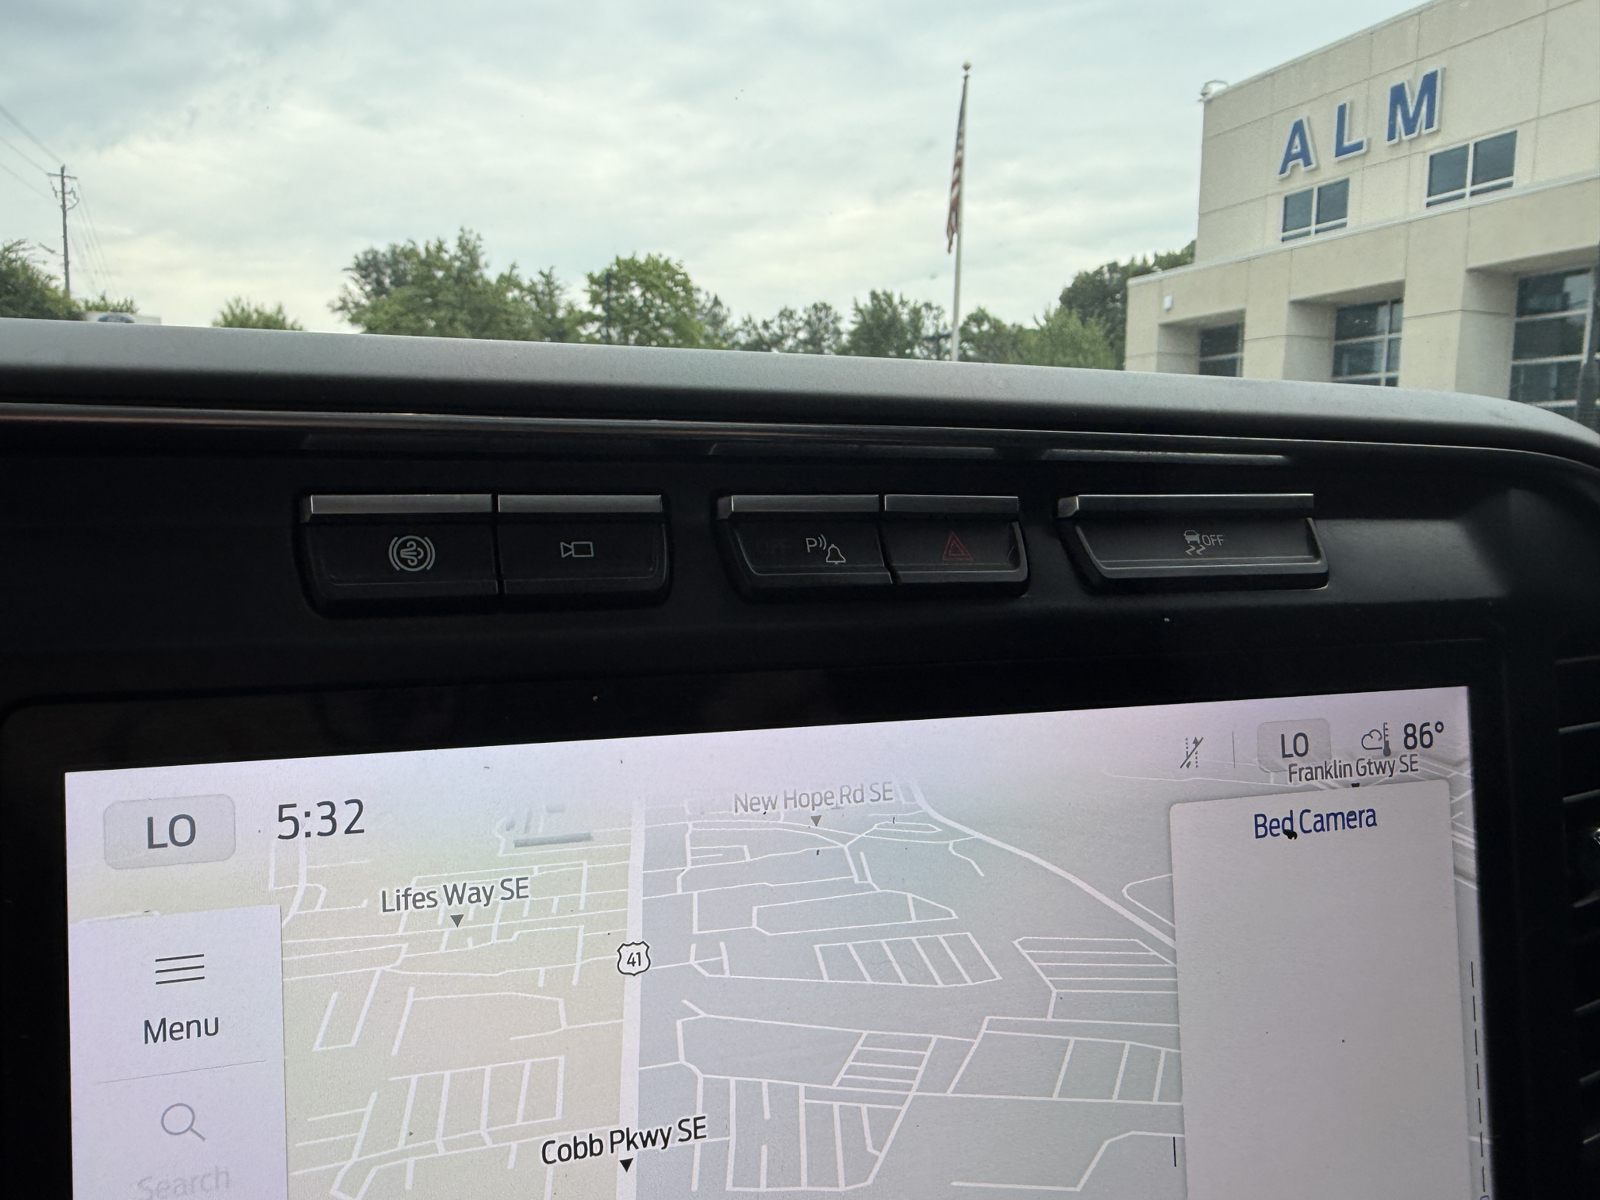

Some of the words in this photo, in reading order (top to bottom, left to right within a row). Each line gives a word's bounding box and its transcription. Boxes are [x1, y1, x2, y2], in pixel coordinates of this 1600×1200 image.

[1278, 70, 1443, 178] ALM
[1201, 534, 1224, 546] OFF
[1281, 732, 1309, 759] LO
[1403, 721, 1445, 750] 86°
[1288, 761, 1352, 783] Franklin
[1356, 757, 1396, 778] Gtwy
[1399, 753, 1419, 773] SE
[734, 793, 778, 813] New
[783, 788, 835, 811] Hope
[839, 783, 865, 804] Rd
[869, 782, 894, 802] SE
[147, 814, 196, 849] LO
[277, 798, 365, 840] 5:32
[1254, 810, 1294, 839] Bed
[1300, 808, 1377, 834] Camera
[381, 889, 438, 913] Lifes
[443, 882, 494, 907] Way
[500, 877, 529, 900] SE
[626, 951, 642, 967] 41
[143, 1016, 219, 1045] Menu
[541, 1133, 604, 1165] Cobb
[609, 1127, 672, 1153] Pkwy
[677, 1116, 707, 1142] SE
[137, 1166, 231, 1200] Search
